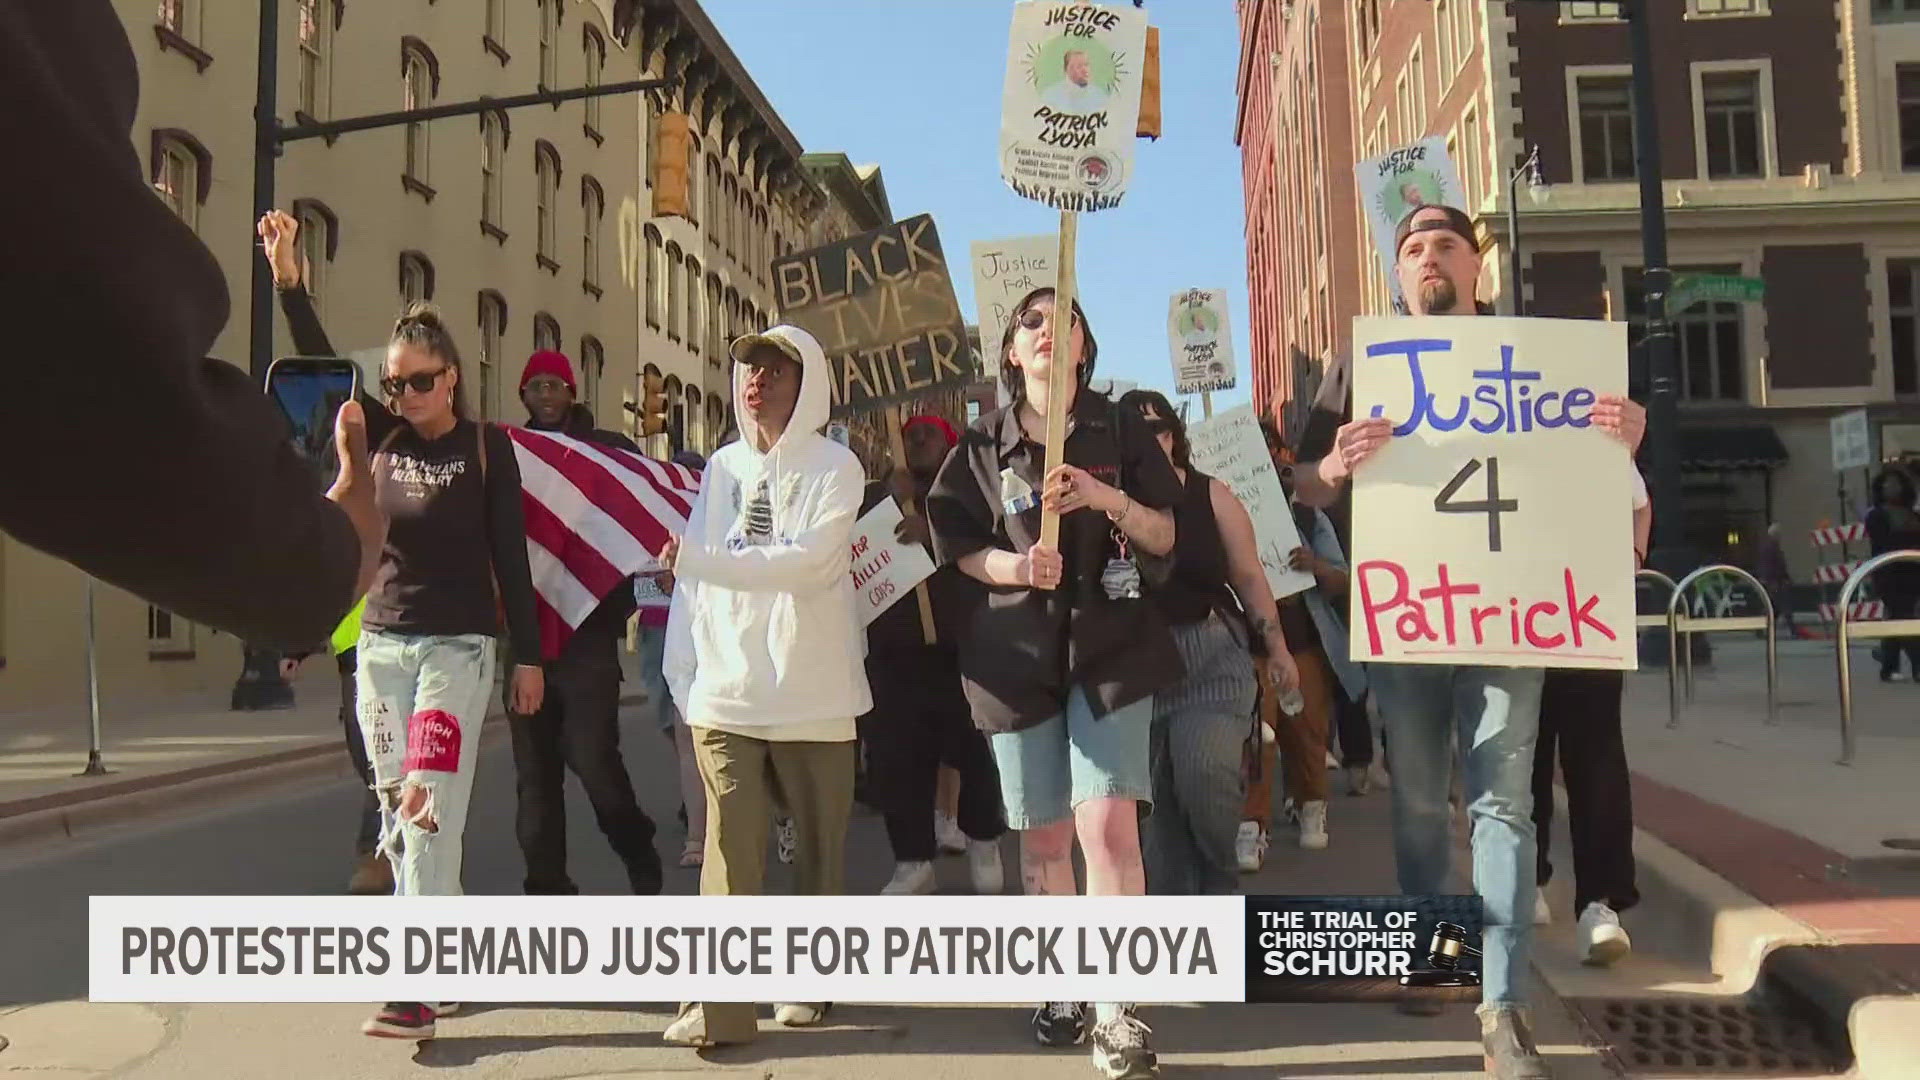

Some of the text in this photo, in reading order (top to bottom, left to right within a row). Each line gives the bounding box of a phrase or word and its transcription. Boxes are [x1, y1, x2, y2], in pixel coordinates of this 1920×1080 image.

[1044, 6, 1120, 31] JUSTICE
[1063, 23, 1095, 38] FOR
[1034, 106, 1109, 130] PATRICK
[1037, 127, 1097, 148] LYOYA
[1378, 146, 1427, 176] JUSTICE
[1392, 161, 1415, 178] FOR
[779, 218, 940, 309] BLACK
[981, 252, 1049, 279] Justice
[1366, 339, 1596, 437] Justice
[1434, 457, 1518, 552] 4
[868, 577, 896, 608] COPS
[1357, 560, 1616, 656] Patrick
